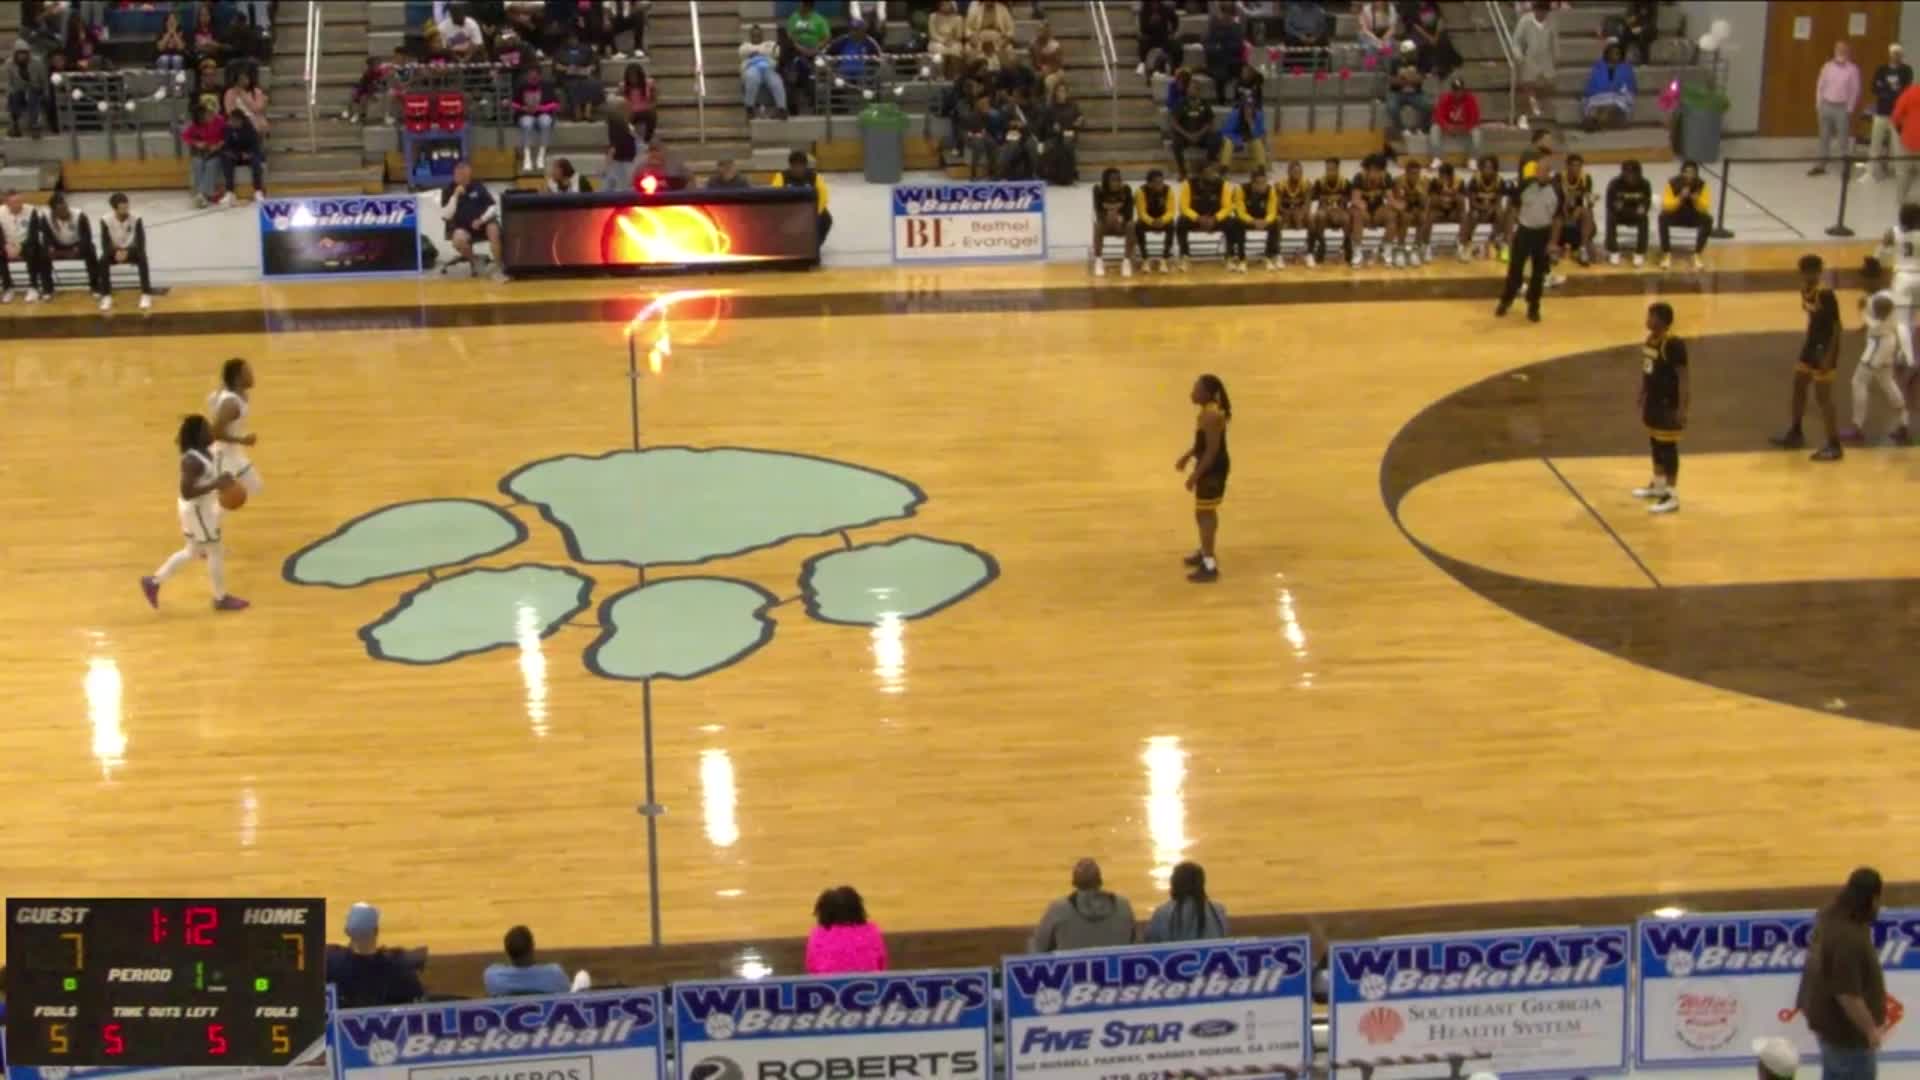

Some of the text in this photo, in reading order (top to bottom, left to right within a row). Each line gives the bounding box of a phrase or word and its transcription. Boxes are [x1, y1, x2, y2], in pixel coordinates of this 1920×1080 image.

[895, 185, 1042, 205] WILDCATS
[962, 235, 1039, 250] Evangel
[970, 219, 1030, 234] Bethel
[1011, 945, 1304, 995] WILDCATS
[1338, 935, 1624, 981] WILDCATS
[1391, 957, 1601, 992] Basketball
[681, 978, 985, 1021] WILDCATS
[1064, 968, 1280, 1006] Basketball
[341, 998, 655, 1047] WILDCATS
[736, 998, 962, 1033] Basketball
[1408, 996, 1602, 1021] SOUTHEAST GEORGIA
[402, 1018, 631, 1056] Basketball
[1019, 1020, 1183, 1054] FIVE STAR
[1428, 1022, 1506, 1041] HEALTH
[1511, 1017, 1582, 1036] SYSTEM
[757, 1050, 979, 1080] ROBERTS
